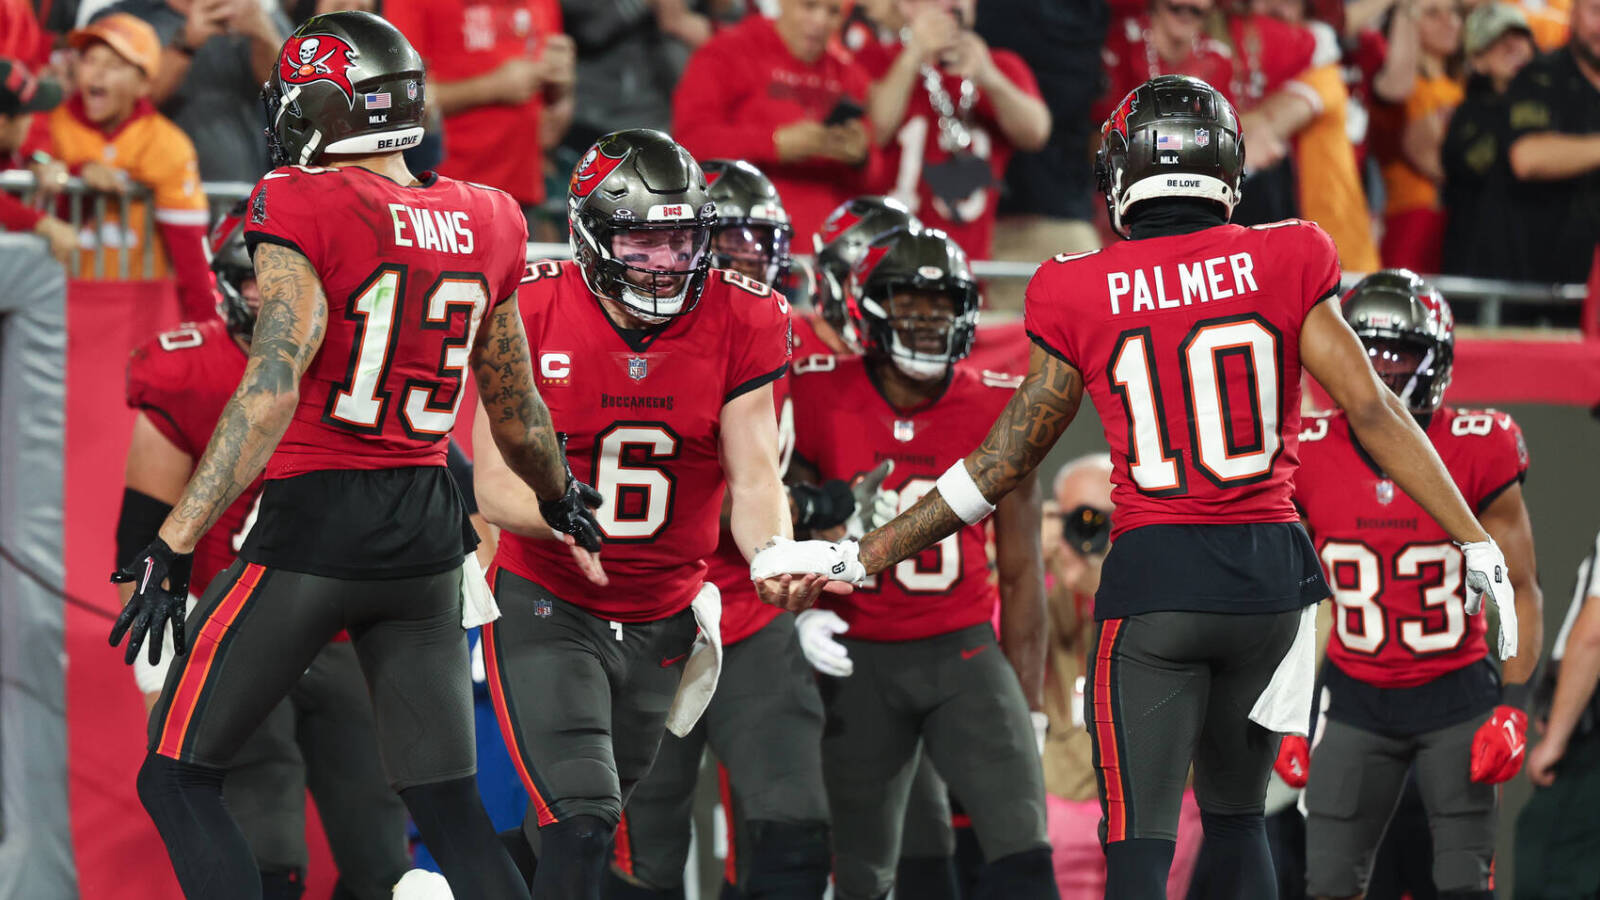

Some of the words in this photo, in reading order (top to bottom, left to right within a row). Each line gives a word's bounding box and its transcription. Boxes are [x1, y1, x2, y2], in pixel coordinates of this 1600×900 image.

[369, 114, 388, 124] MLK
[377, 139, 393, 149] BE
[395, 135, 418, 147] LOVE
[1160, 155, 1179, 165] MLK
[1166, 179, 1178, 187] BE
[1179, 180, 1201, 188] LOVE
[388, 203, 475, 255] EVANS
[1107, 252, 1259, 315] PALMER
[321, 262, 491, 443] 13
[541, 353, 571, 379] C
[1106, 311, 1285, 497] 10
[591, 420, 682, 544] 6
[1318, 540, 1469, 658] 83
